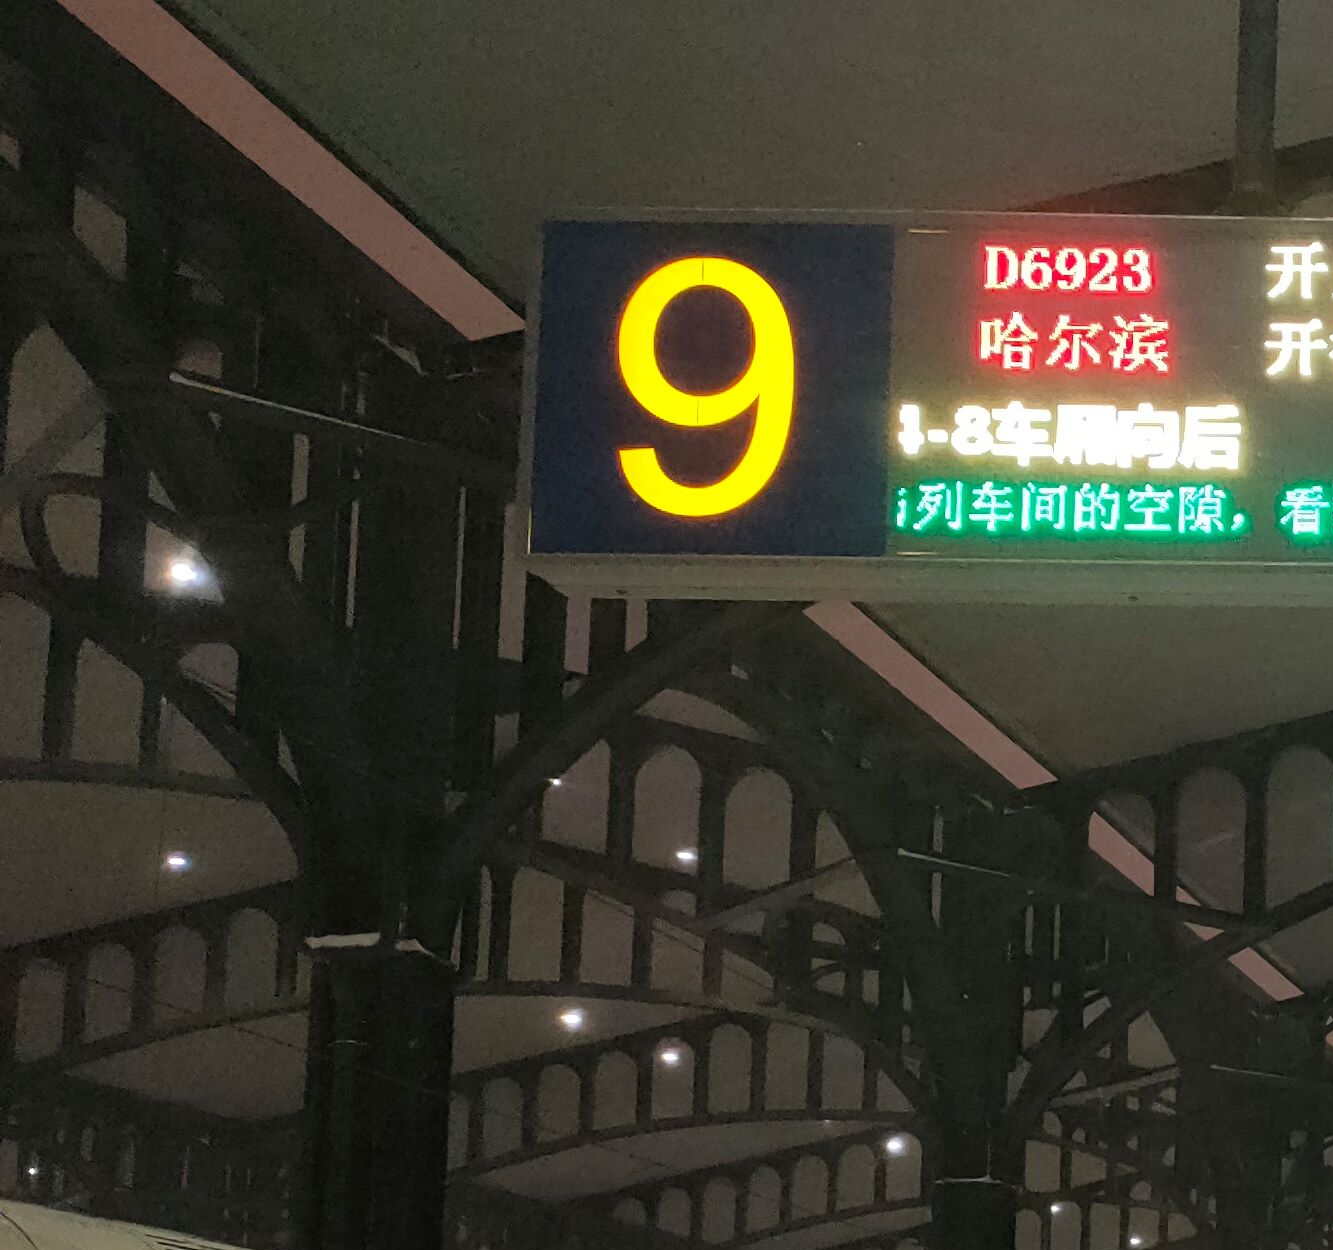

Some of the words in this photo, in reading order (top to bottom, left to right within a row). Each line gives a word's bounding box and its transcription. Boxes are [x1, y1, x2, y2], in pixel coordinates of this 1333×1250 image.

[984, 246, 1152, 292] D6923
[980, 311, 1169, 372] 哈尔滨
[617, 256, 794, 517] 9
